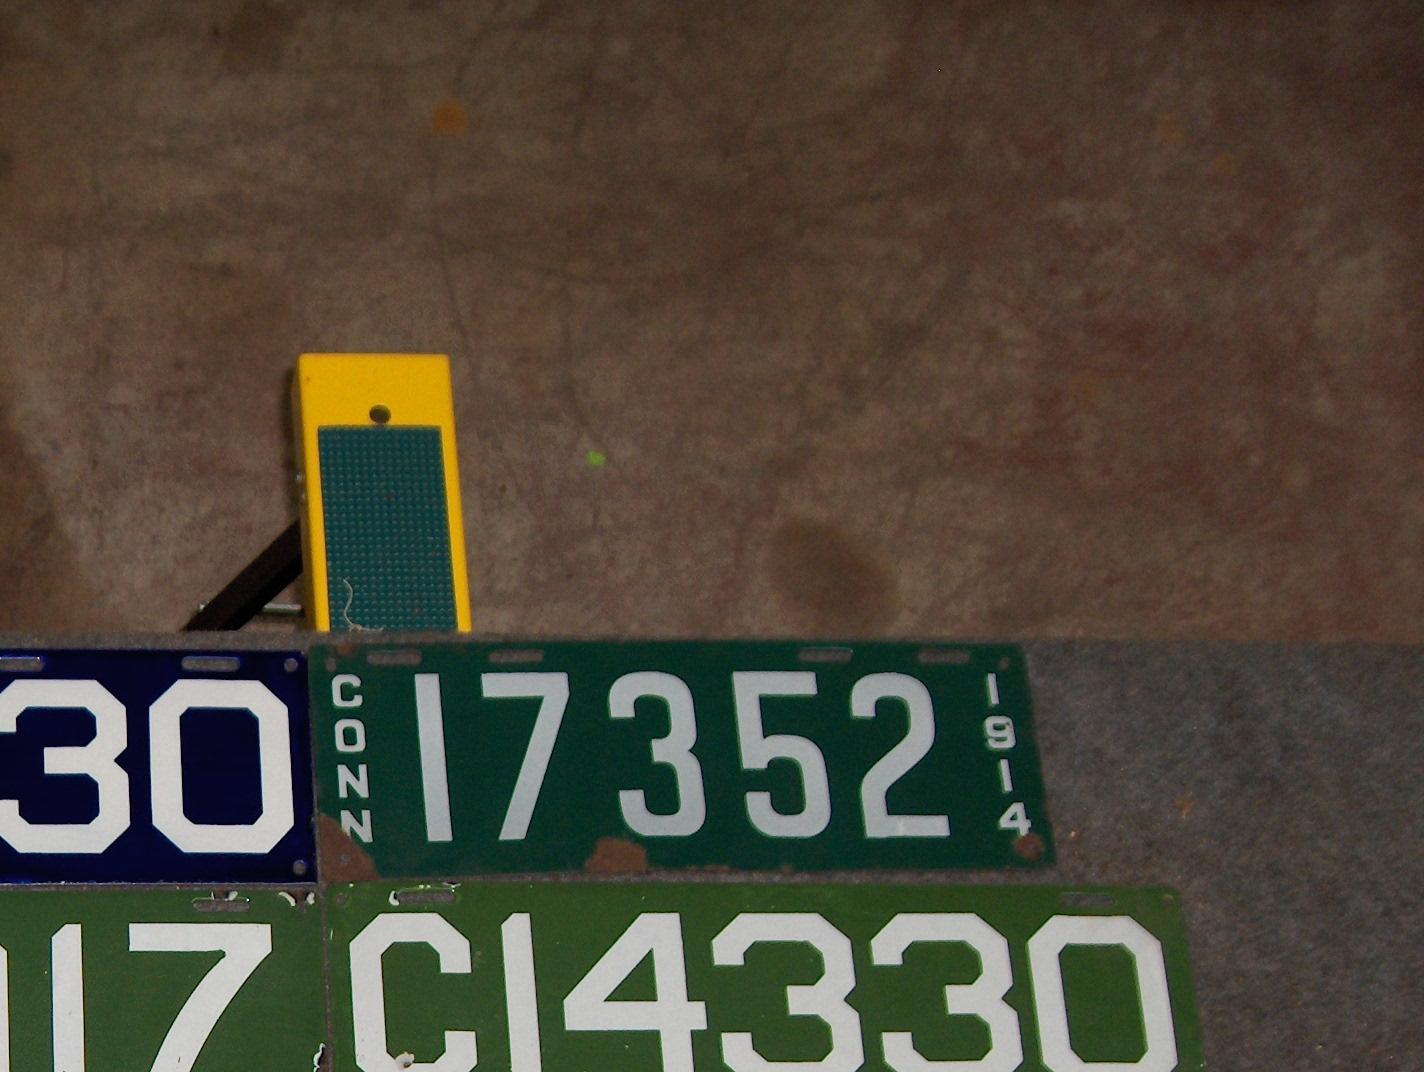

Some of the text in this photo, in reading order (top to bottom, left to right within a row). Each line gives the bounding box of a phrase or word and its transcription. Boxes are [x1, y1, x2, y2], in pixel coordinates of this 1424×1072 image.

[332, 673, 374, 844] CONN
[415, 670, 950, 843] 17352
[986, 673, 1032, 836] 1914
